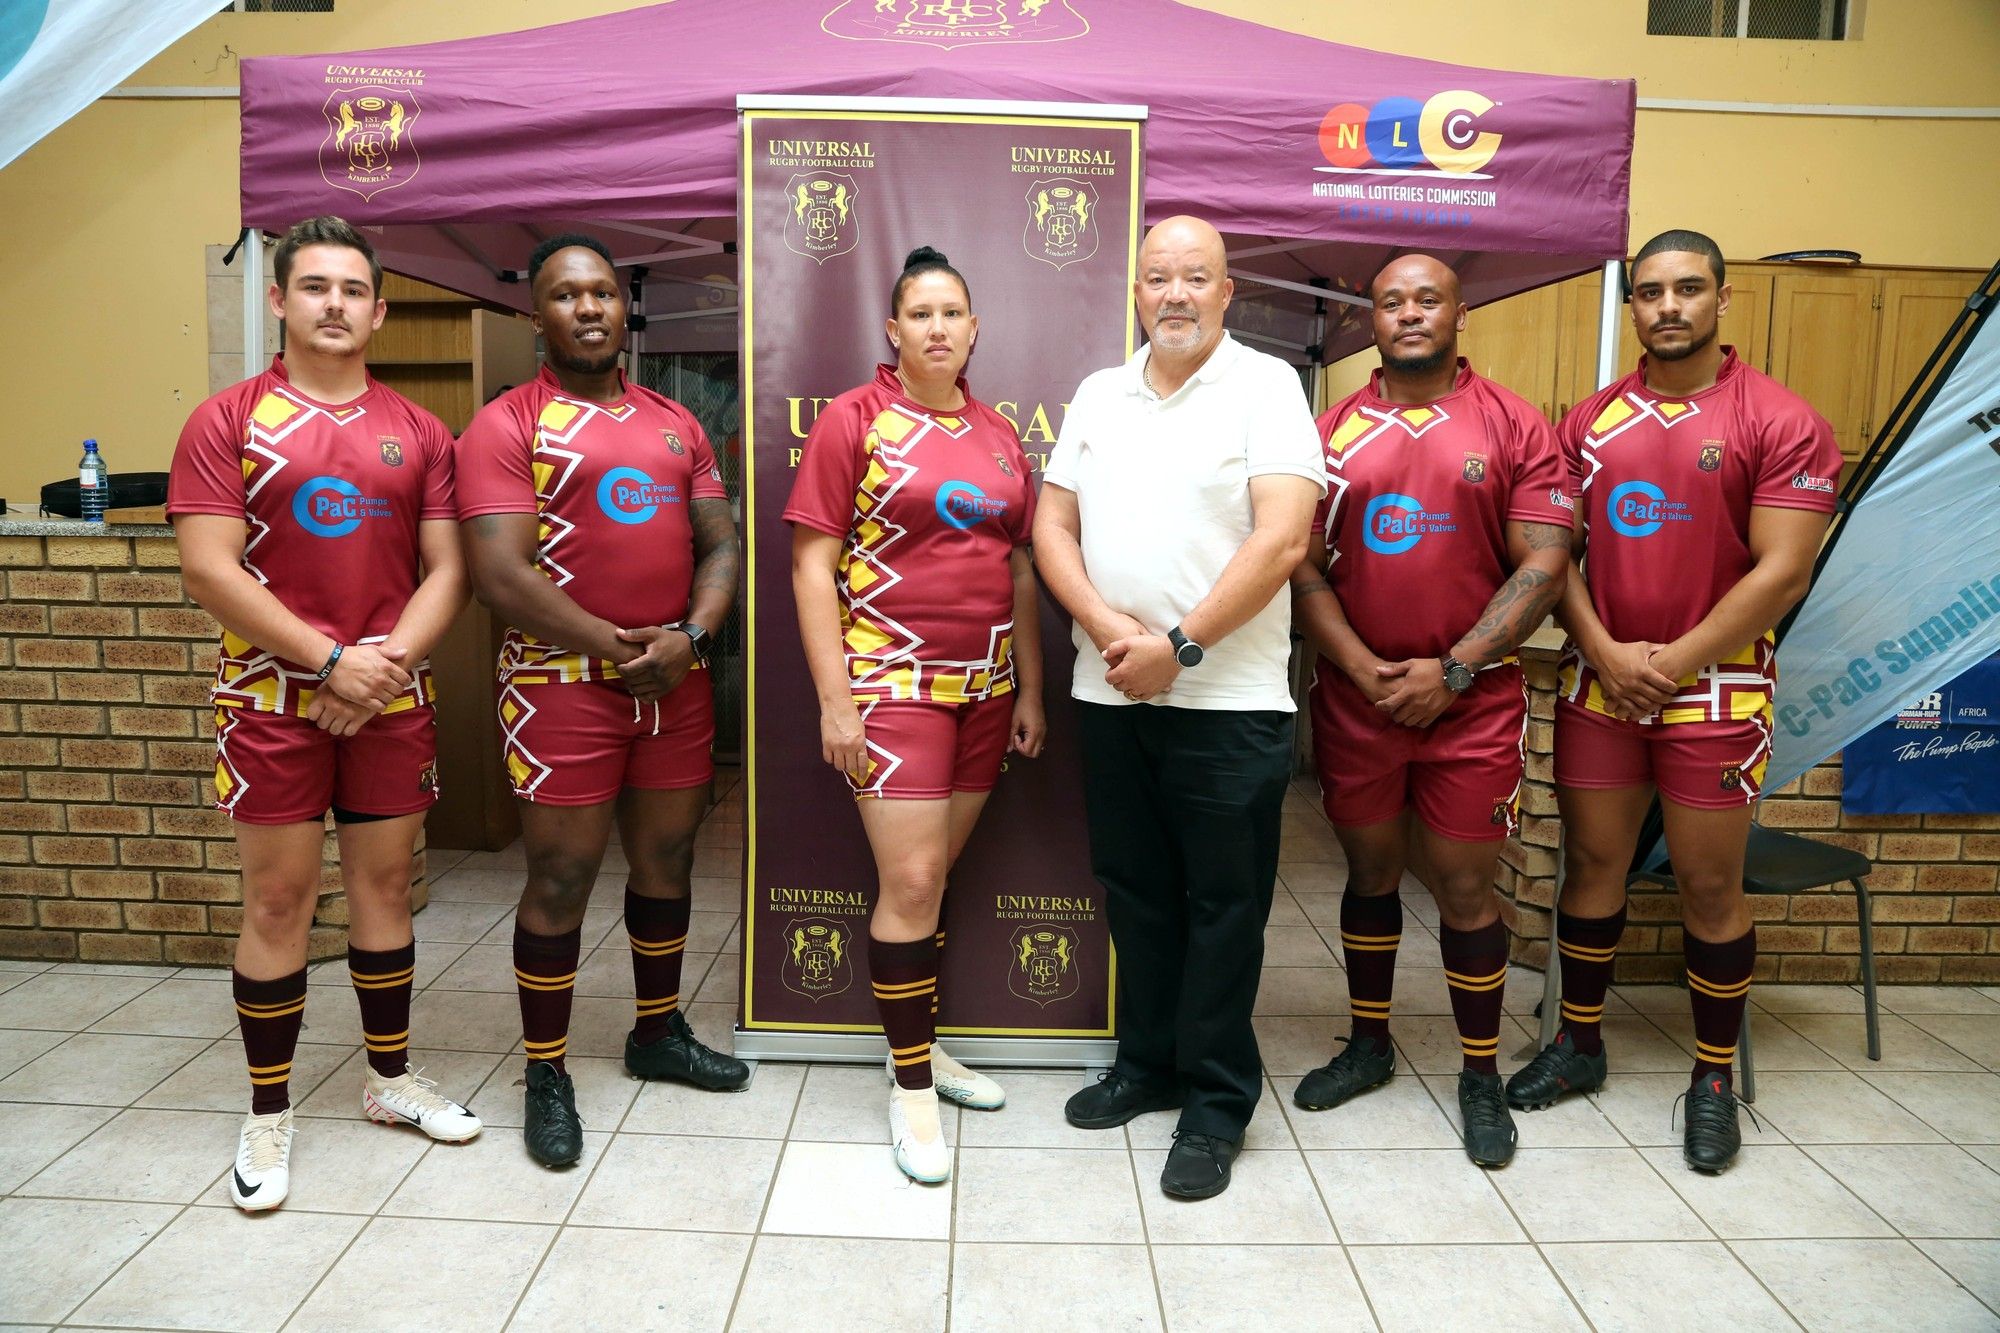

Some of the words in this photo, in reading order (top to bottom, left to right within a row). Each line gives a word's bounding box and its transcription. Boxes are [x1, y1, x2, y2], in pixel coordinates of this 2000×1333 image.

[326, 65, 426, 78] UNIVERSAL
[325, 76, 353, 84] RUGBY
[355, 77, 399, 85] FOOTBALL
[401, 78, 423, 86] CLUB
[769, 140, 876, 158] UNIVERSAL
[1011, 146, 1116, 165] UNIVERSAL
[769, 157, 800, 166] RUGBY
[802, 158, 849, 167] FOOTBALL
[850, 159, 875, 168] CLUB
[1011, 165, 1042, 173] RUGBY
[1043, 165, 1089, 175] FOOTBALL
[1091, 167, 1115, 176] CLUB
[347, 172, 391, 183] KIMBERLEY
[1312, 182, 1366, 199] NATIONAL
[1368, 185, 1424, 203] LOTTERIES
[1427, 188, 1496, 207] COMMISSION
[805, 241, 837, 251] Kimberley
[1044, 247, 1076, 257] Kimberley
[653, 484, 677, 493] Pumps
[359, 497, 388, 506] Pumps
[1663, 501, 1687, 511] Pumps
[1420, 511, 1451, 521] Pumps
[1429, 523, 1457, 533] Valves
[1777, 657, 1882, 738] C-PaC
[1958, 707, 1988, 717] AFRICA
[1895, 720, 1942, 730] PUMPS
[1892, 741, 1922, 762] The
[1921, 735, 1959, 760] Pump
[1959, 730, 1996, 754] People
[770, 888, 868, 906] UNIVERSAL
[996, 895, 1096, 912] UNIVERSAL
[770, 904, 798, 913] RUGBY
[800, 905, 844, 915] FOOTBALL
[845, 907, 867, 916] CLUB
[996, 911, 1025, 919] RUGBY
[1027, 912, 1072, 920] FOOTBALL
[1072, 913, 1095, 921] CLUB
[1028, 986, 1059, 996] Kimberley
